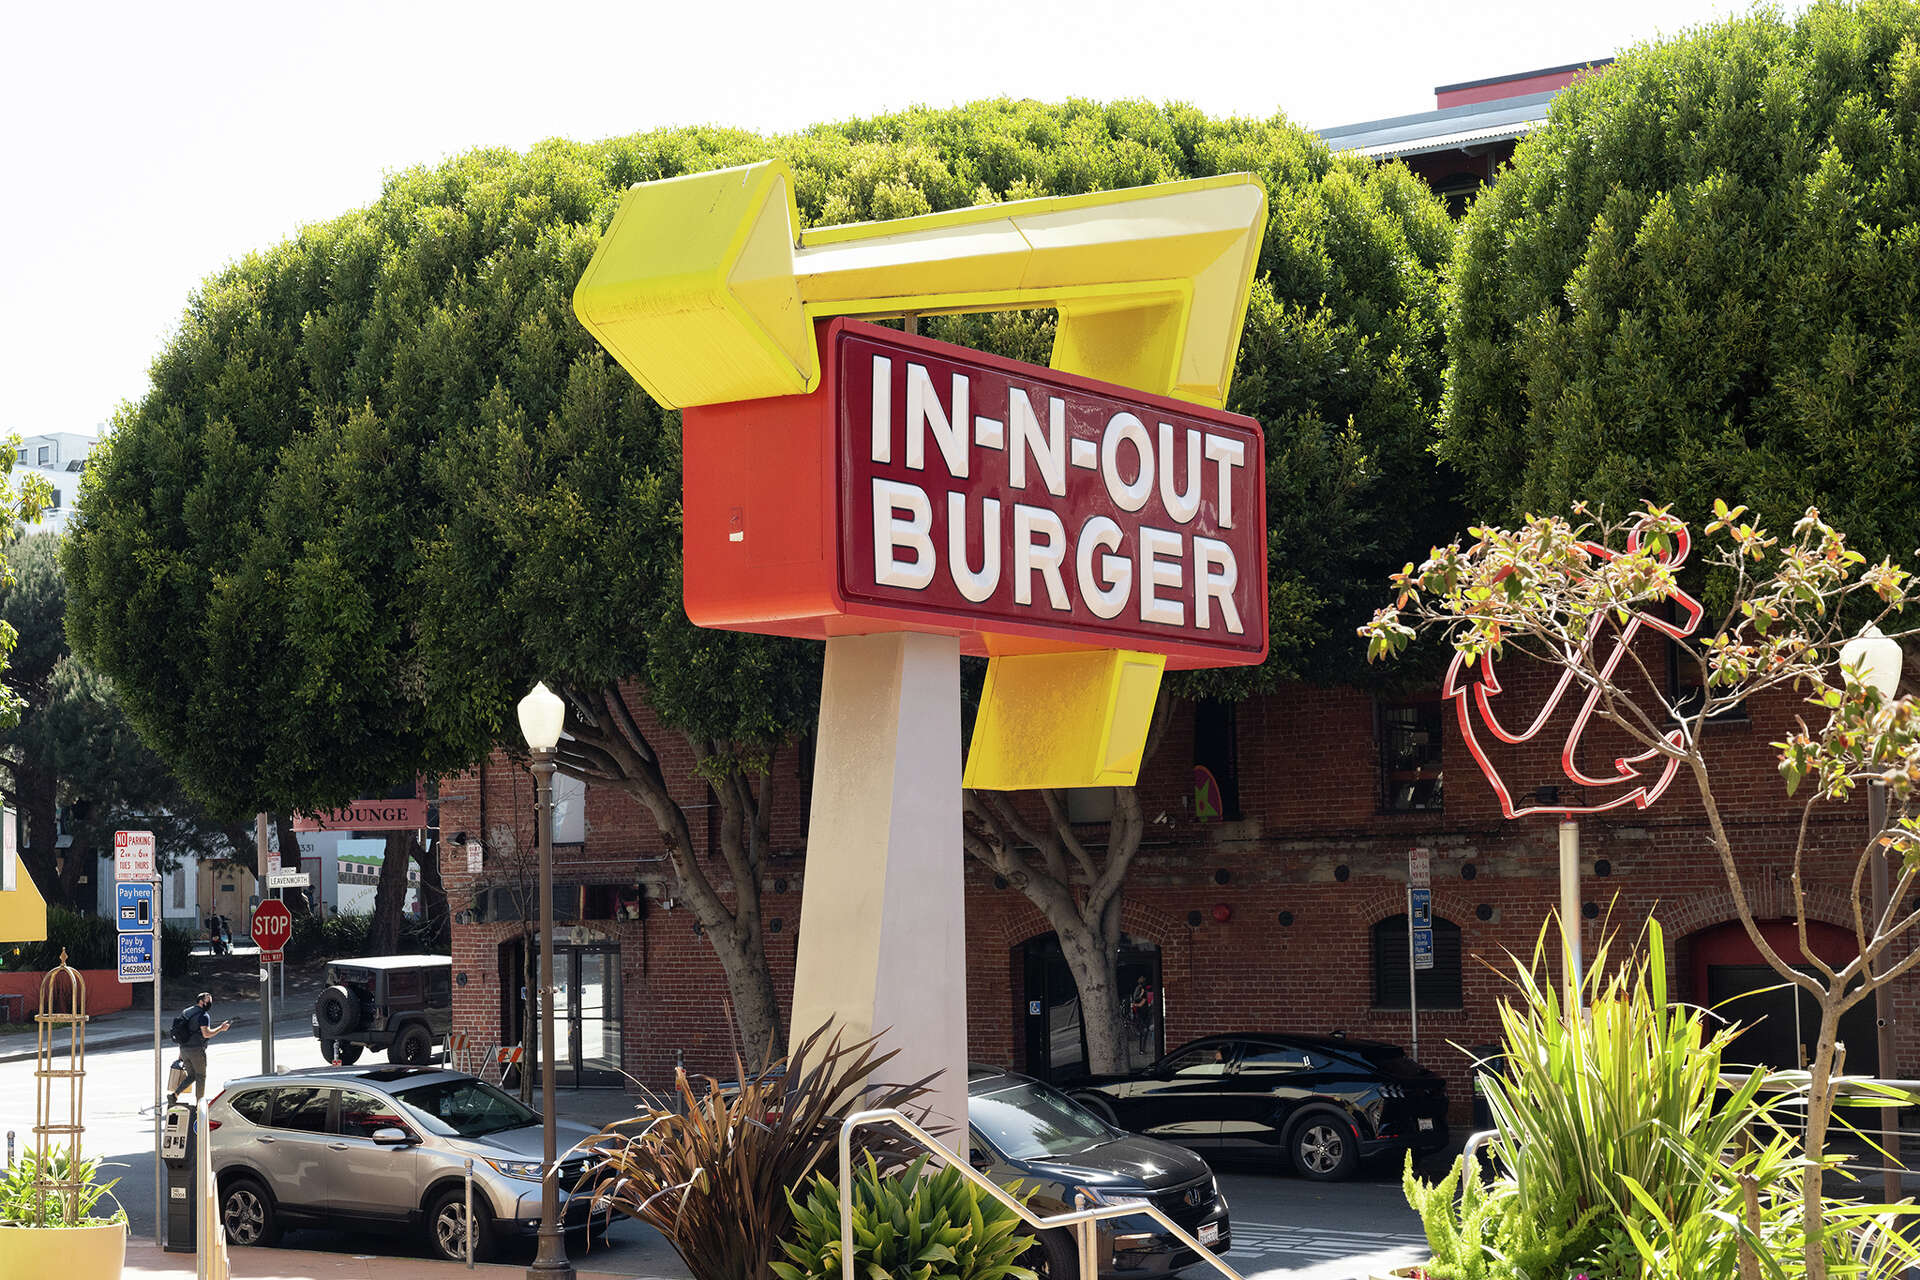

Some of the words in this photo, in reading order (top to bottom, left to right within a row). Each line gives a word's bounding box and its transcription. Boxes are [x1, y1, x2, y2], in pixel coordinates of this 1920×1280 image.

[871, 355, 1244, 529] IN-N-OUT
[872, 478, 1244, 635] BURGER
[330, 807, 409, 822] LOUNGE
[116, 833, 127, 846] NO
[129, 836, 151, 846] PARKING
[120, 861, 131, 869] TUES
[271, 876, 308, 885] LEAVENWORTH
[119, 888, 133, 899] Pay
[133, 888, 151, 897] here
[254, 916, 288, 935] STOP
[121, 937, 133, 946] Pay
[134, 936, 144, 946] by
[121, 945, 145, 954] License
[121, 954, 138, 963] Plate
